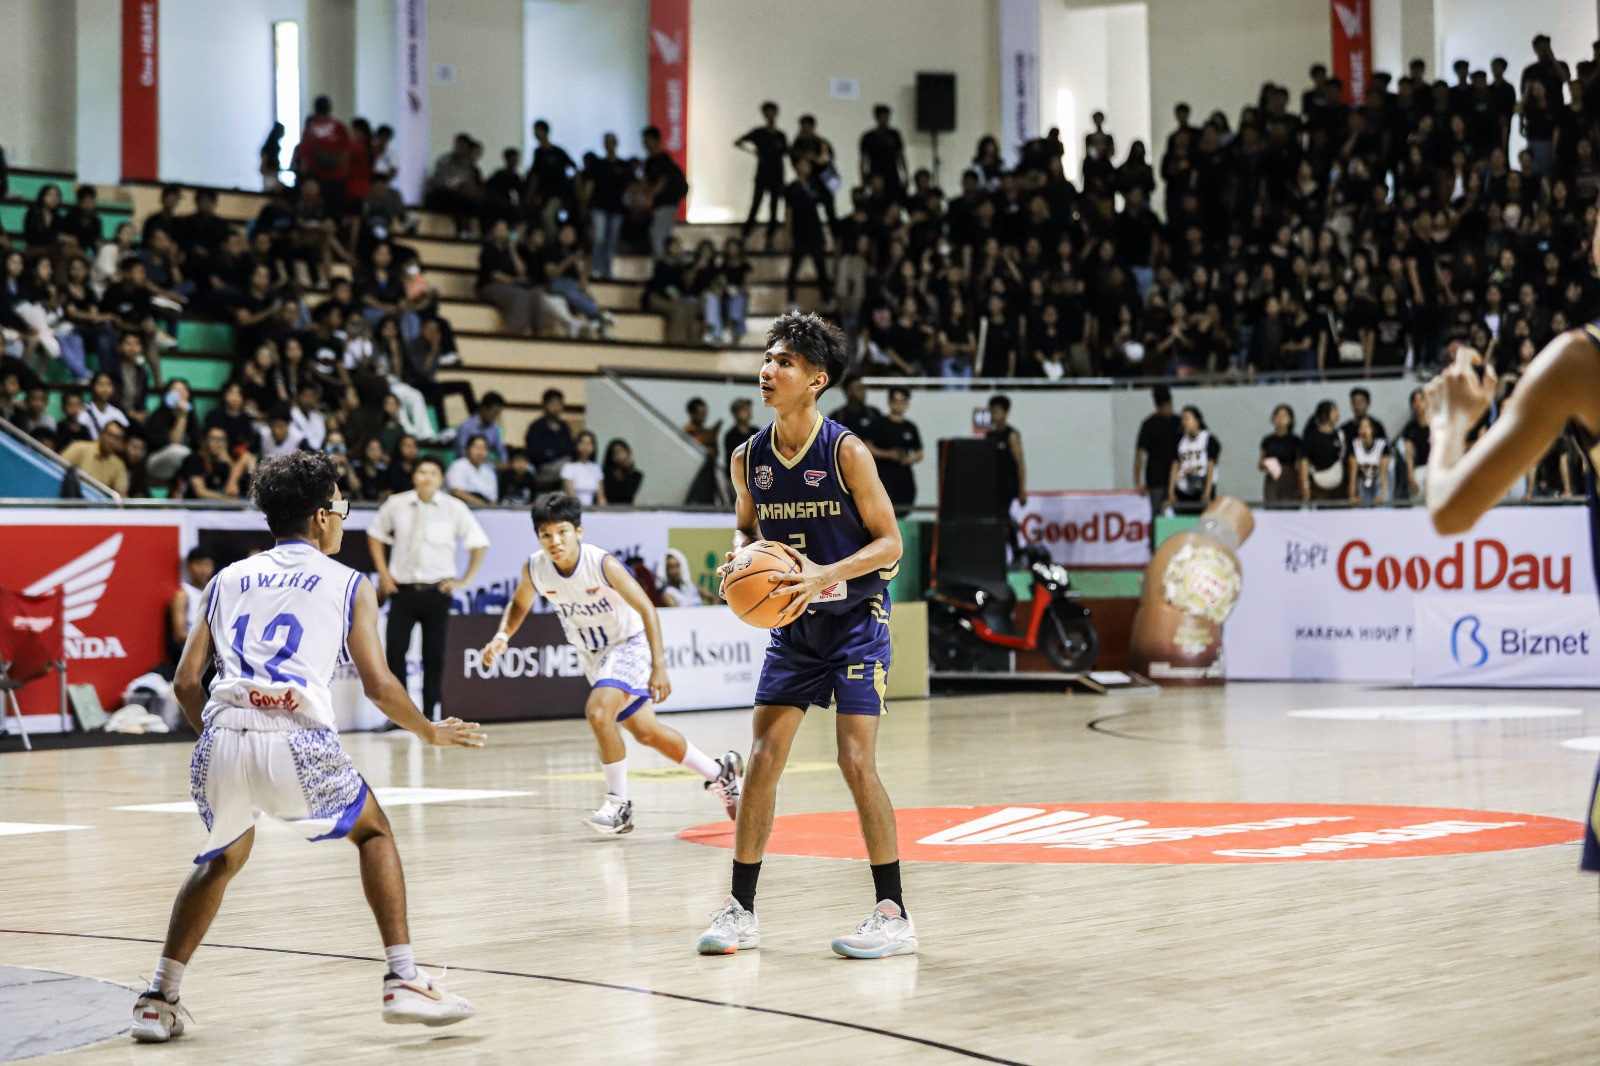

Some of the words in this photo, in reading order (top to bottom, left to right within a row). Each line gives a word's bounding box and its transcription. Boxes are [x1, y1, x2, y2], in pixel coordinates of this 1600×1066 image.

[1021, 512, 1099, 545] Good
[1336, 538, 1464, 592] Good
[1473, 538, 1572, 596] Day
[64, 635, 128, 660] NDA
[230, 612, 308, 688] 12
[663, 629, 752, 668] ackson
[1500, 627, 1590, 656] Biznet
[545, 644, 586, 679] ME
